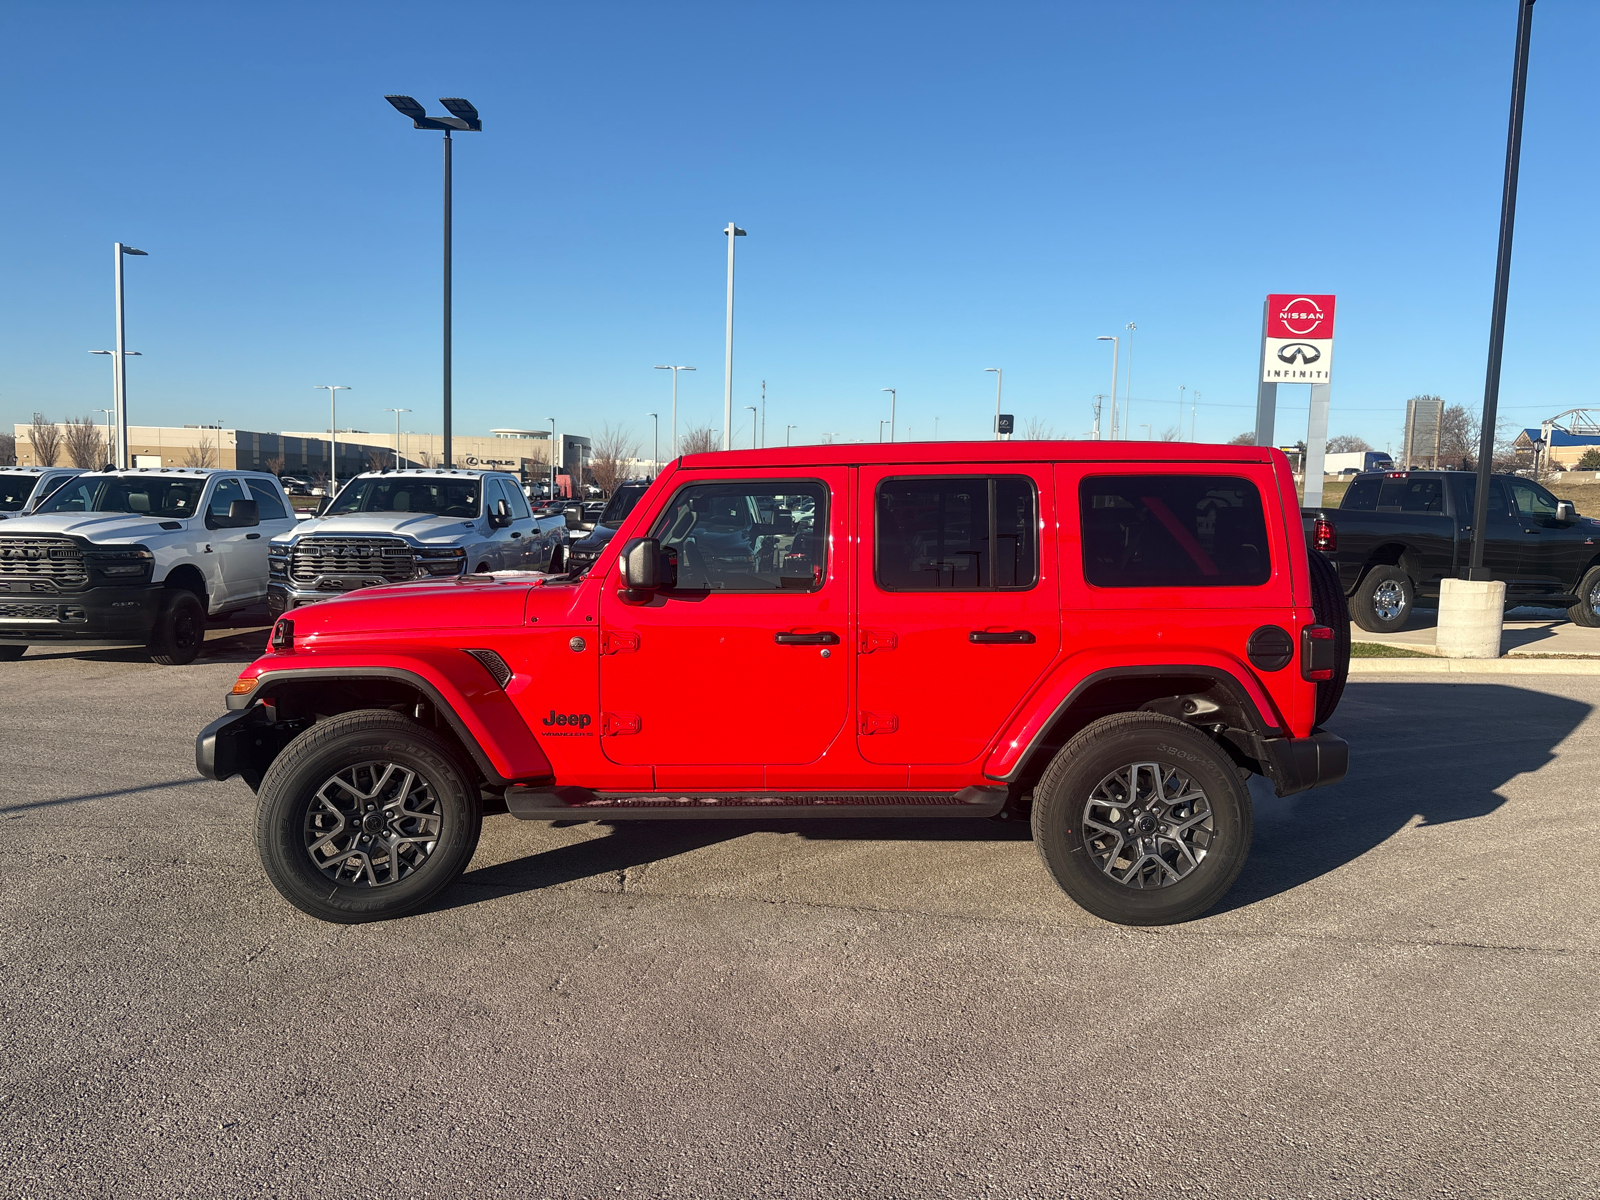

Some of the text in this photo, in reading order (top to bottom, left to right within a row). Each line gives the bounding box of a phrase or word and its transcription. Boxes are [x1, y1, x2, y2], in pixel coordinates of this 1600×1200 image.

[1280, 312, 1324, 320] NISSAN
[1267, 369, 1329, 379] INFINITI
[321, 546, 380, 557] RAM
[542, 710, 592, 729] Jeep
